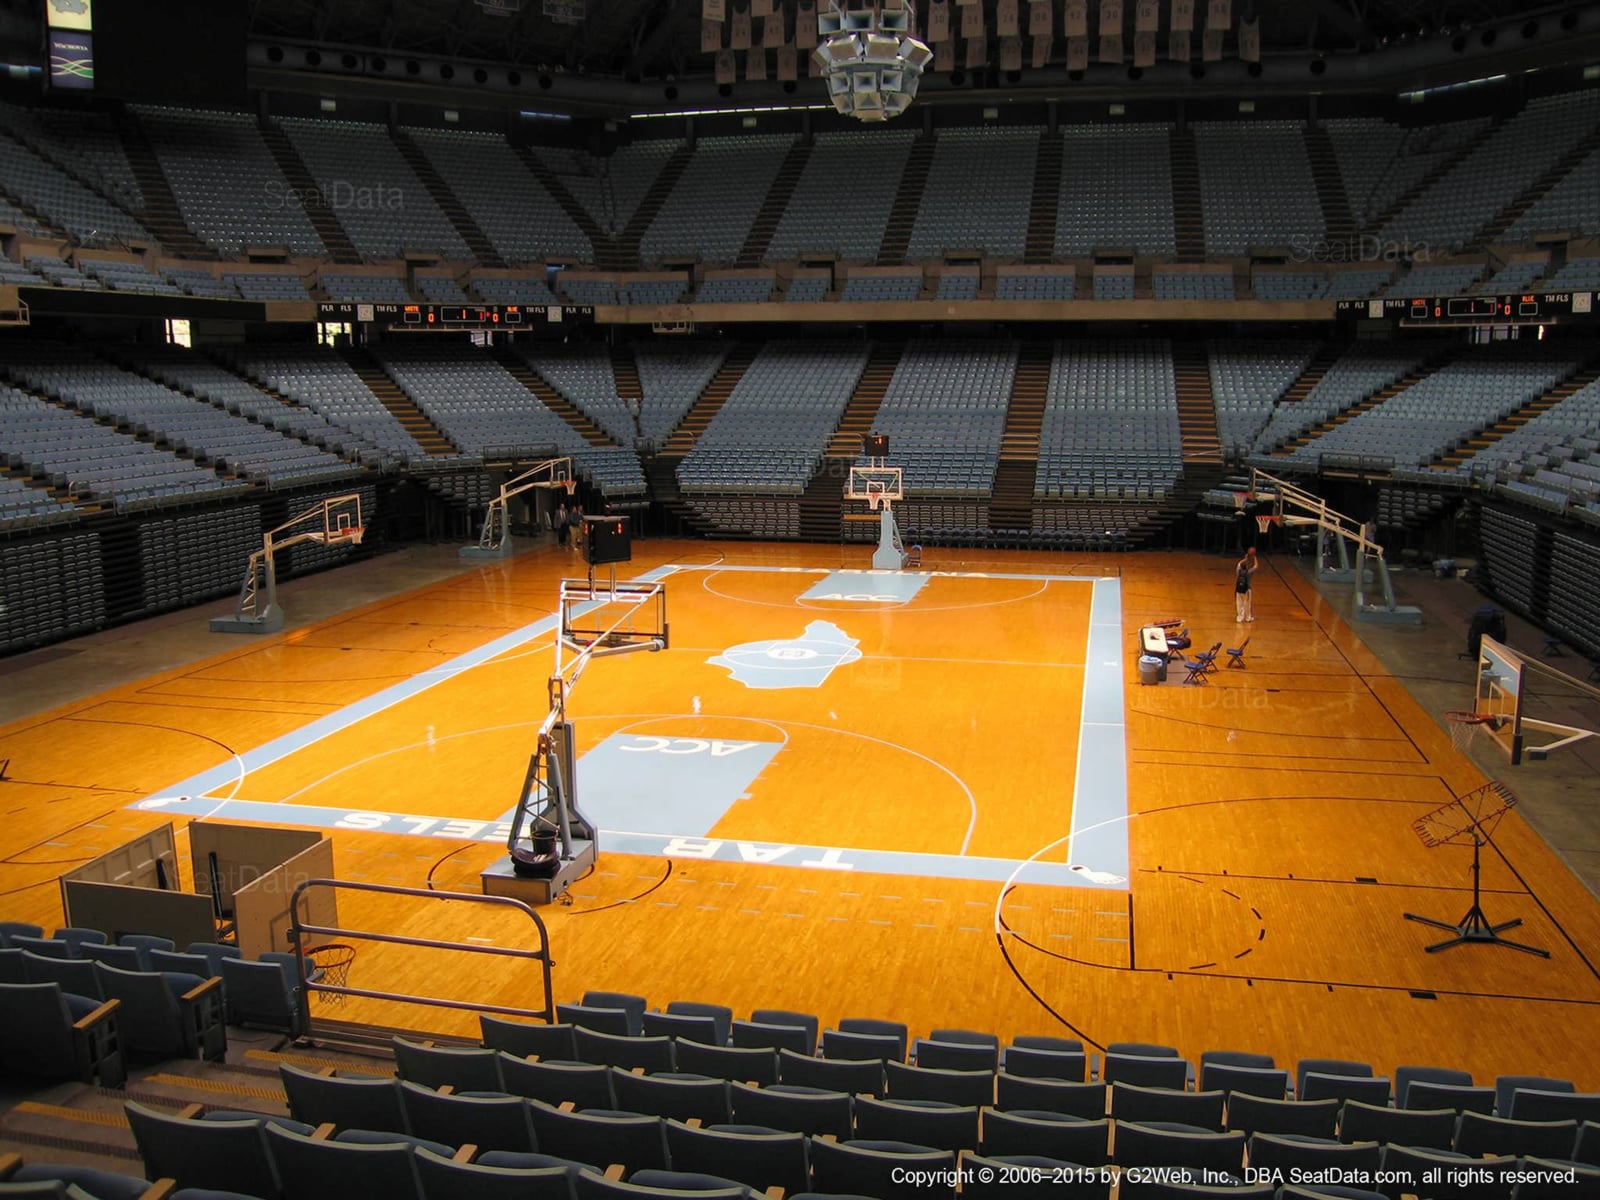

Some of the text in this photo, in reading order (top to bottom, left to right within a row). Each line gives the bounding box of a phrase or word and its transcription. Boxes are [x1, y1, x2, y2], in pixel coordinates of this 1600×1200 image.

[807, 592, 900, 602] ACC
[618, 736, 761, 757] ACC
[333, 812, 854, 870] TAR EELS
